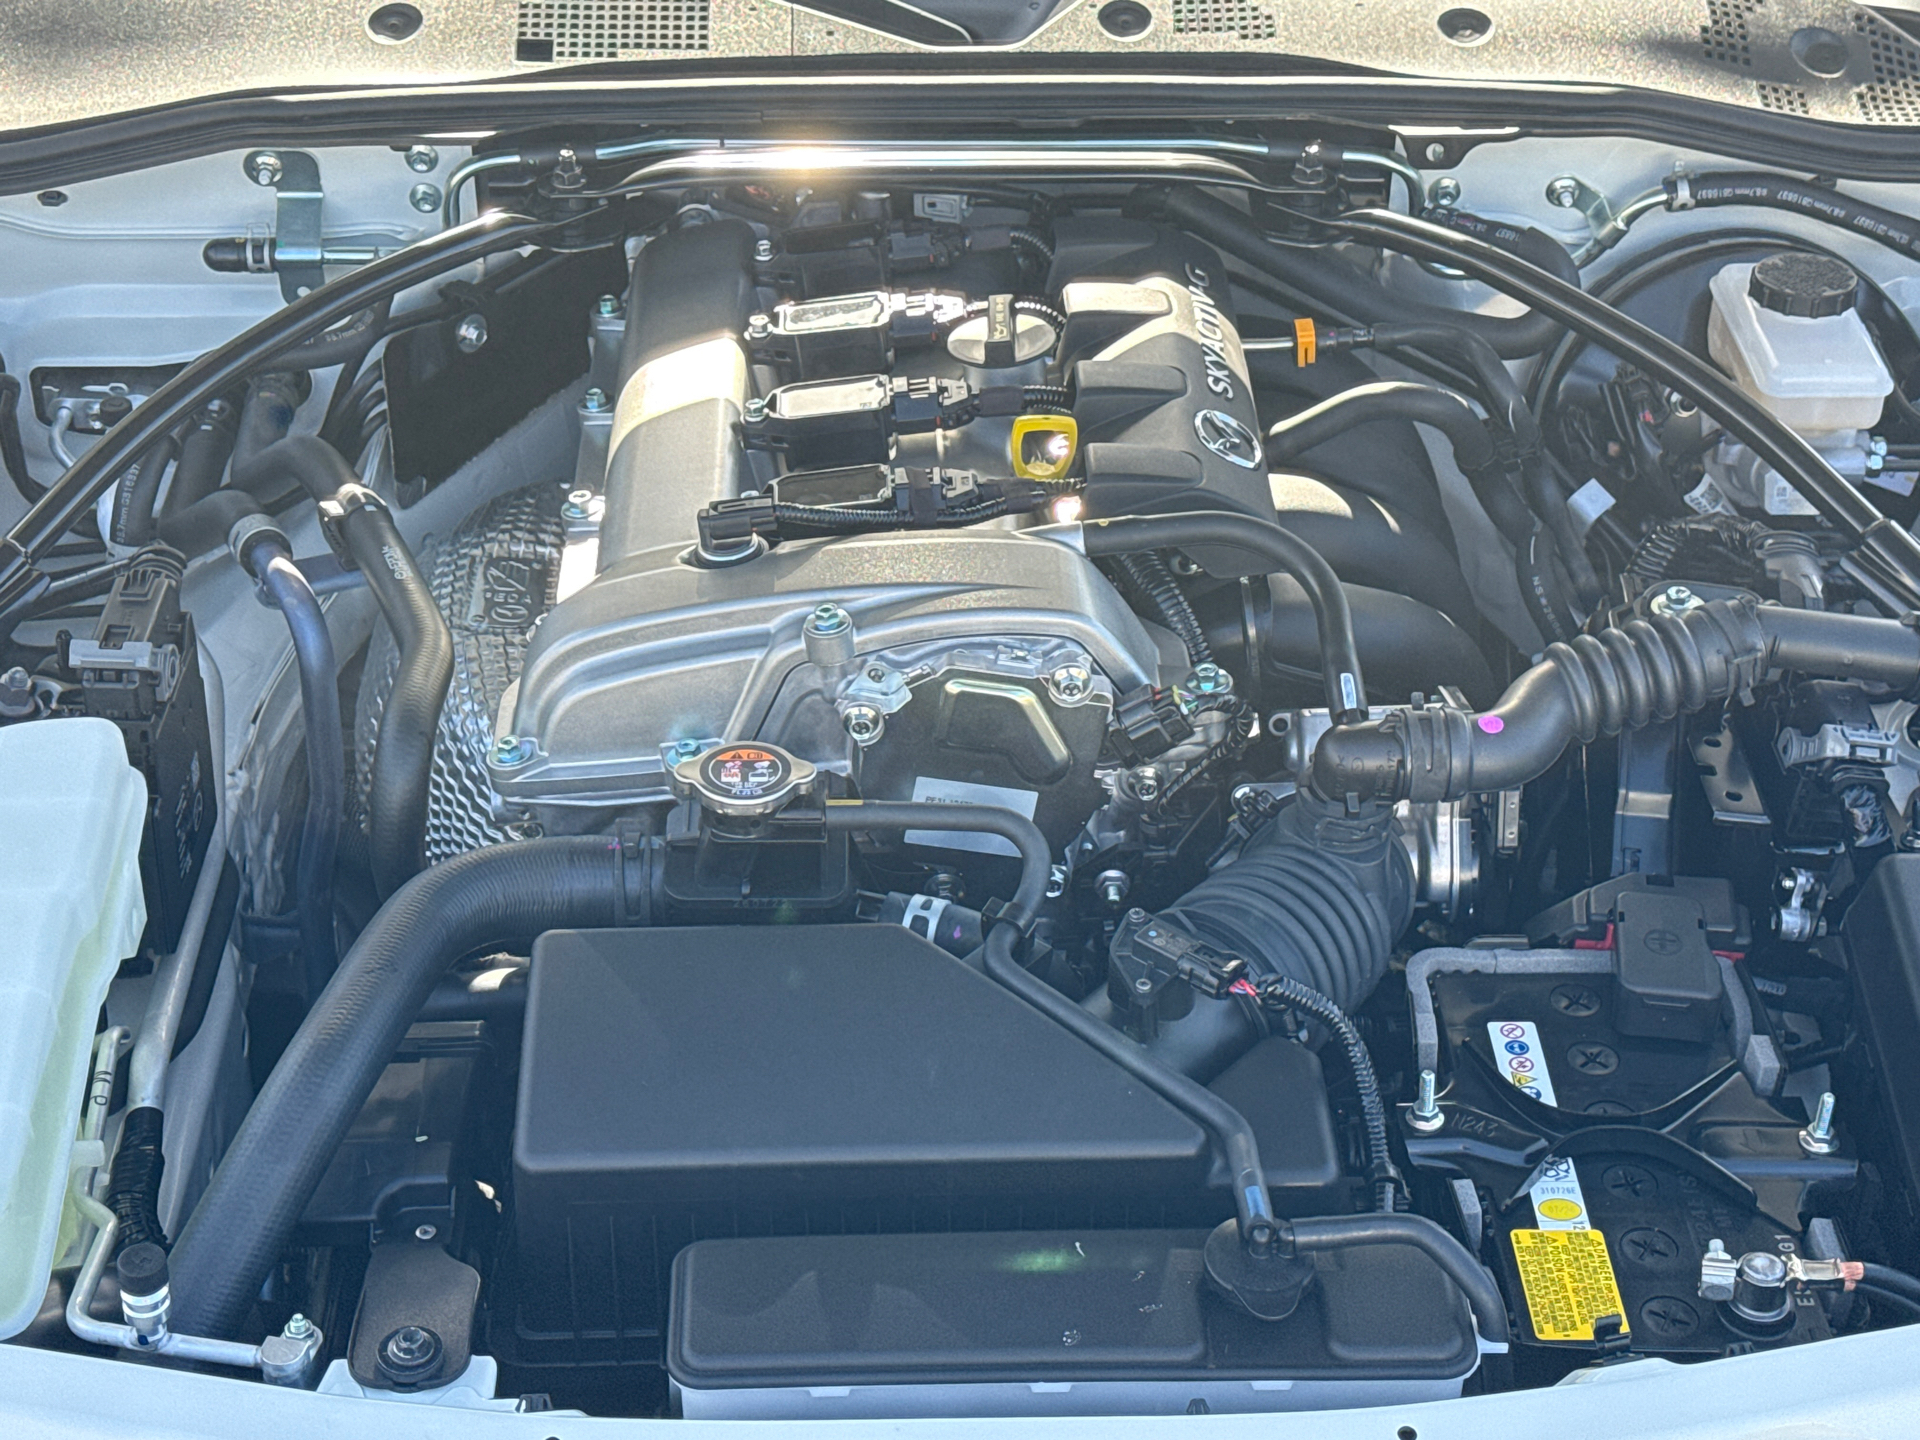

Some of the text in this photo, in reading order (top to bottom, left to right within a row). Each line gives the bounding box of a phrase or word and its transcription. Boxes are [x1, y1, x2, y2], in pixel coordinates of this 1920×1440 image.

[1185, 263, 1233, 398] SKYACTIV-G
[1523, 1245, 1533, 1257] KEEP
[1560, 1244, 1571, 1255] KEEP
[1527, 1258, 1536, 1267] OUT
[1548, 1245, 1565, 1272] POISON
[1563, 1257, 1574, 1269] VENT
[1593, 1248, 1612, 1281] DANGER
[1566, 1270, 1578, 1283] CAPS
